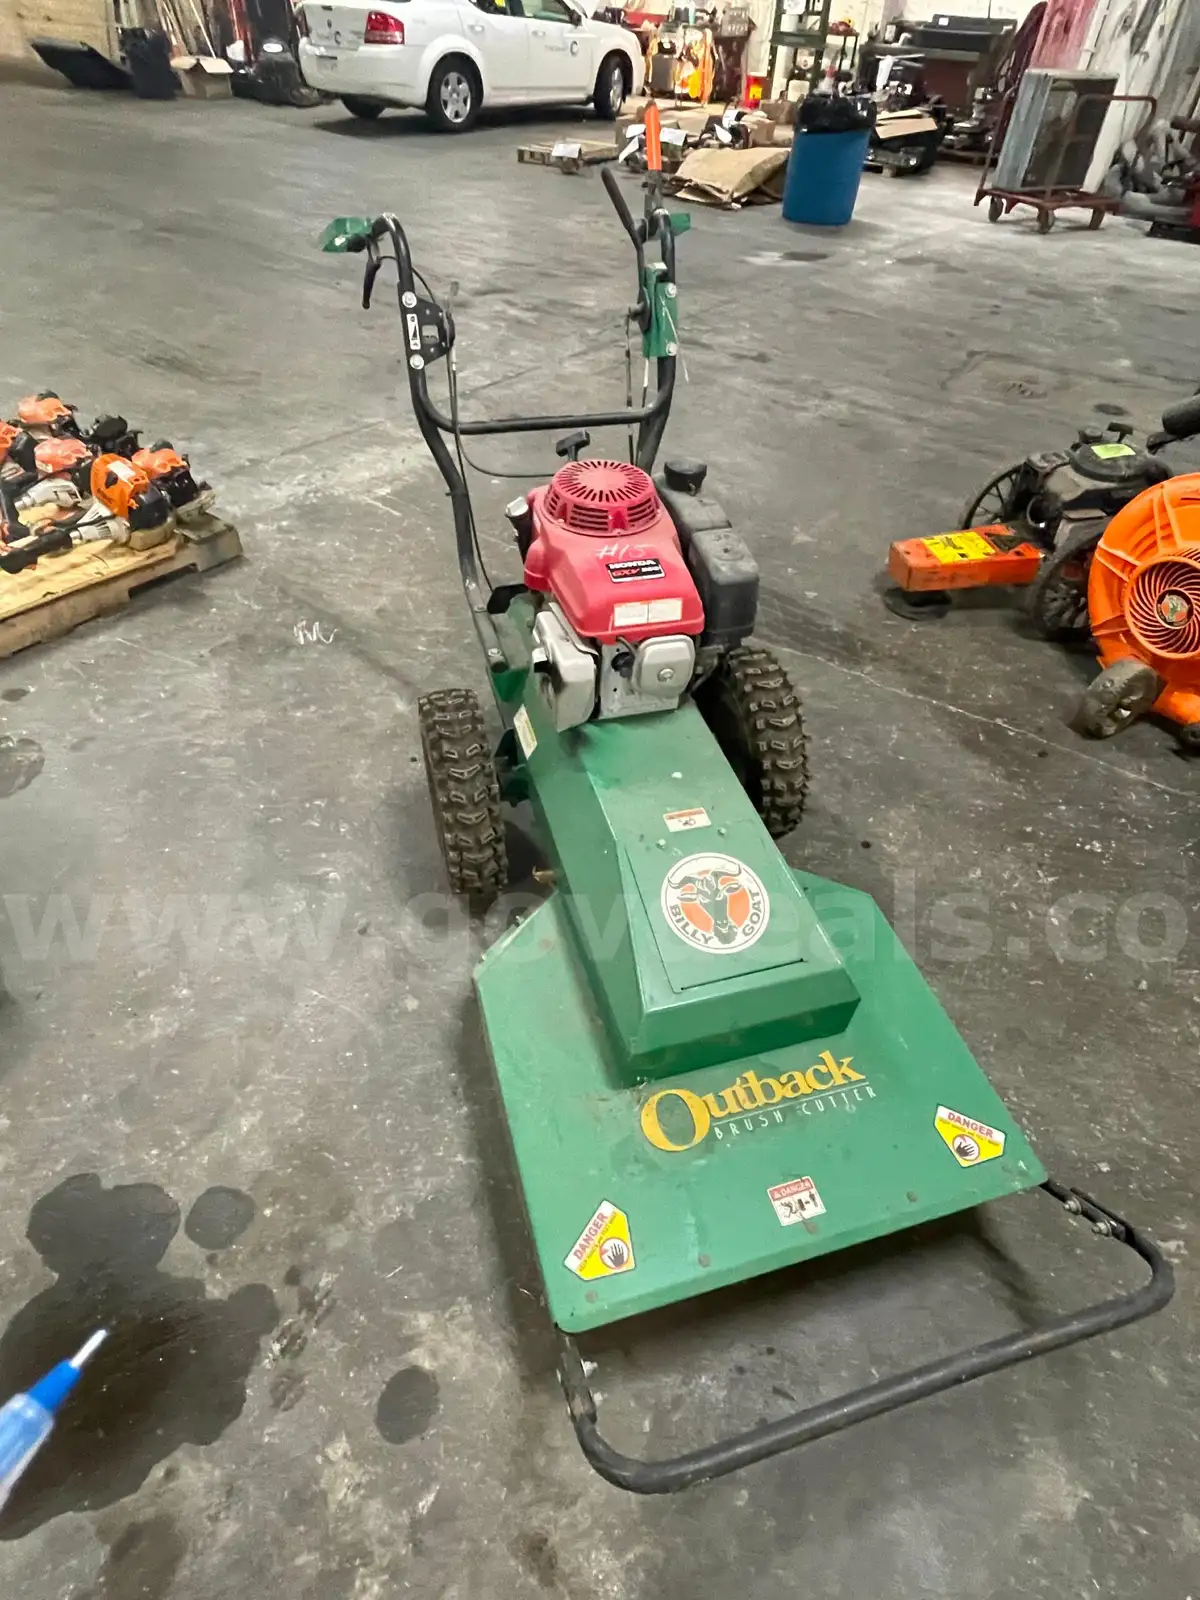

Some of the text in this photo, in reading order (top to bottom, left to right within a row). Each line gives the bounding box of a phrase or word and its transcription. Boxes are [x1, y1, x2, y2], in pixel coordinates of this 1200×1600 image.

[608, 560, 657, 569] HONDA
[669, 904, 713, 945] BILLY
[742, 888, 762, 937] GOAT
[641, 1050, 866, 1152] Outback
[713, 1086, 877, 1140] BRUSH CUTTER
[947, 1111, 994, 1138] DANGER
[573, 1212, 609, 1260] DANGER
